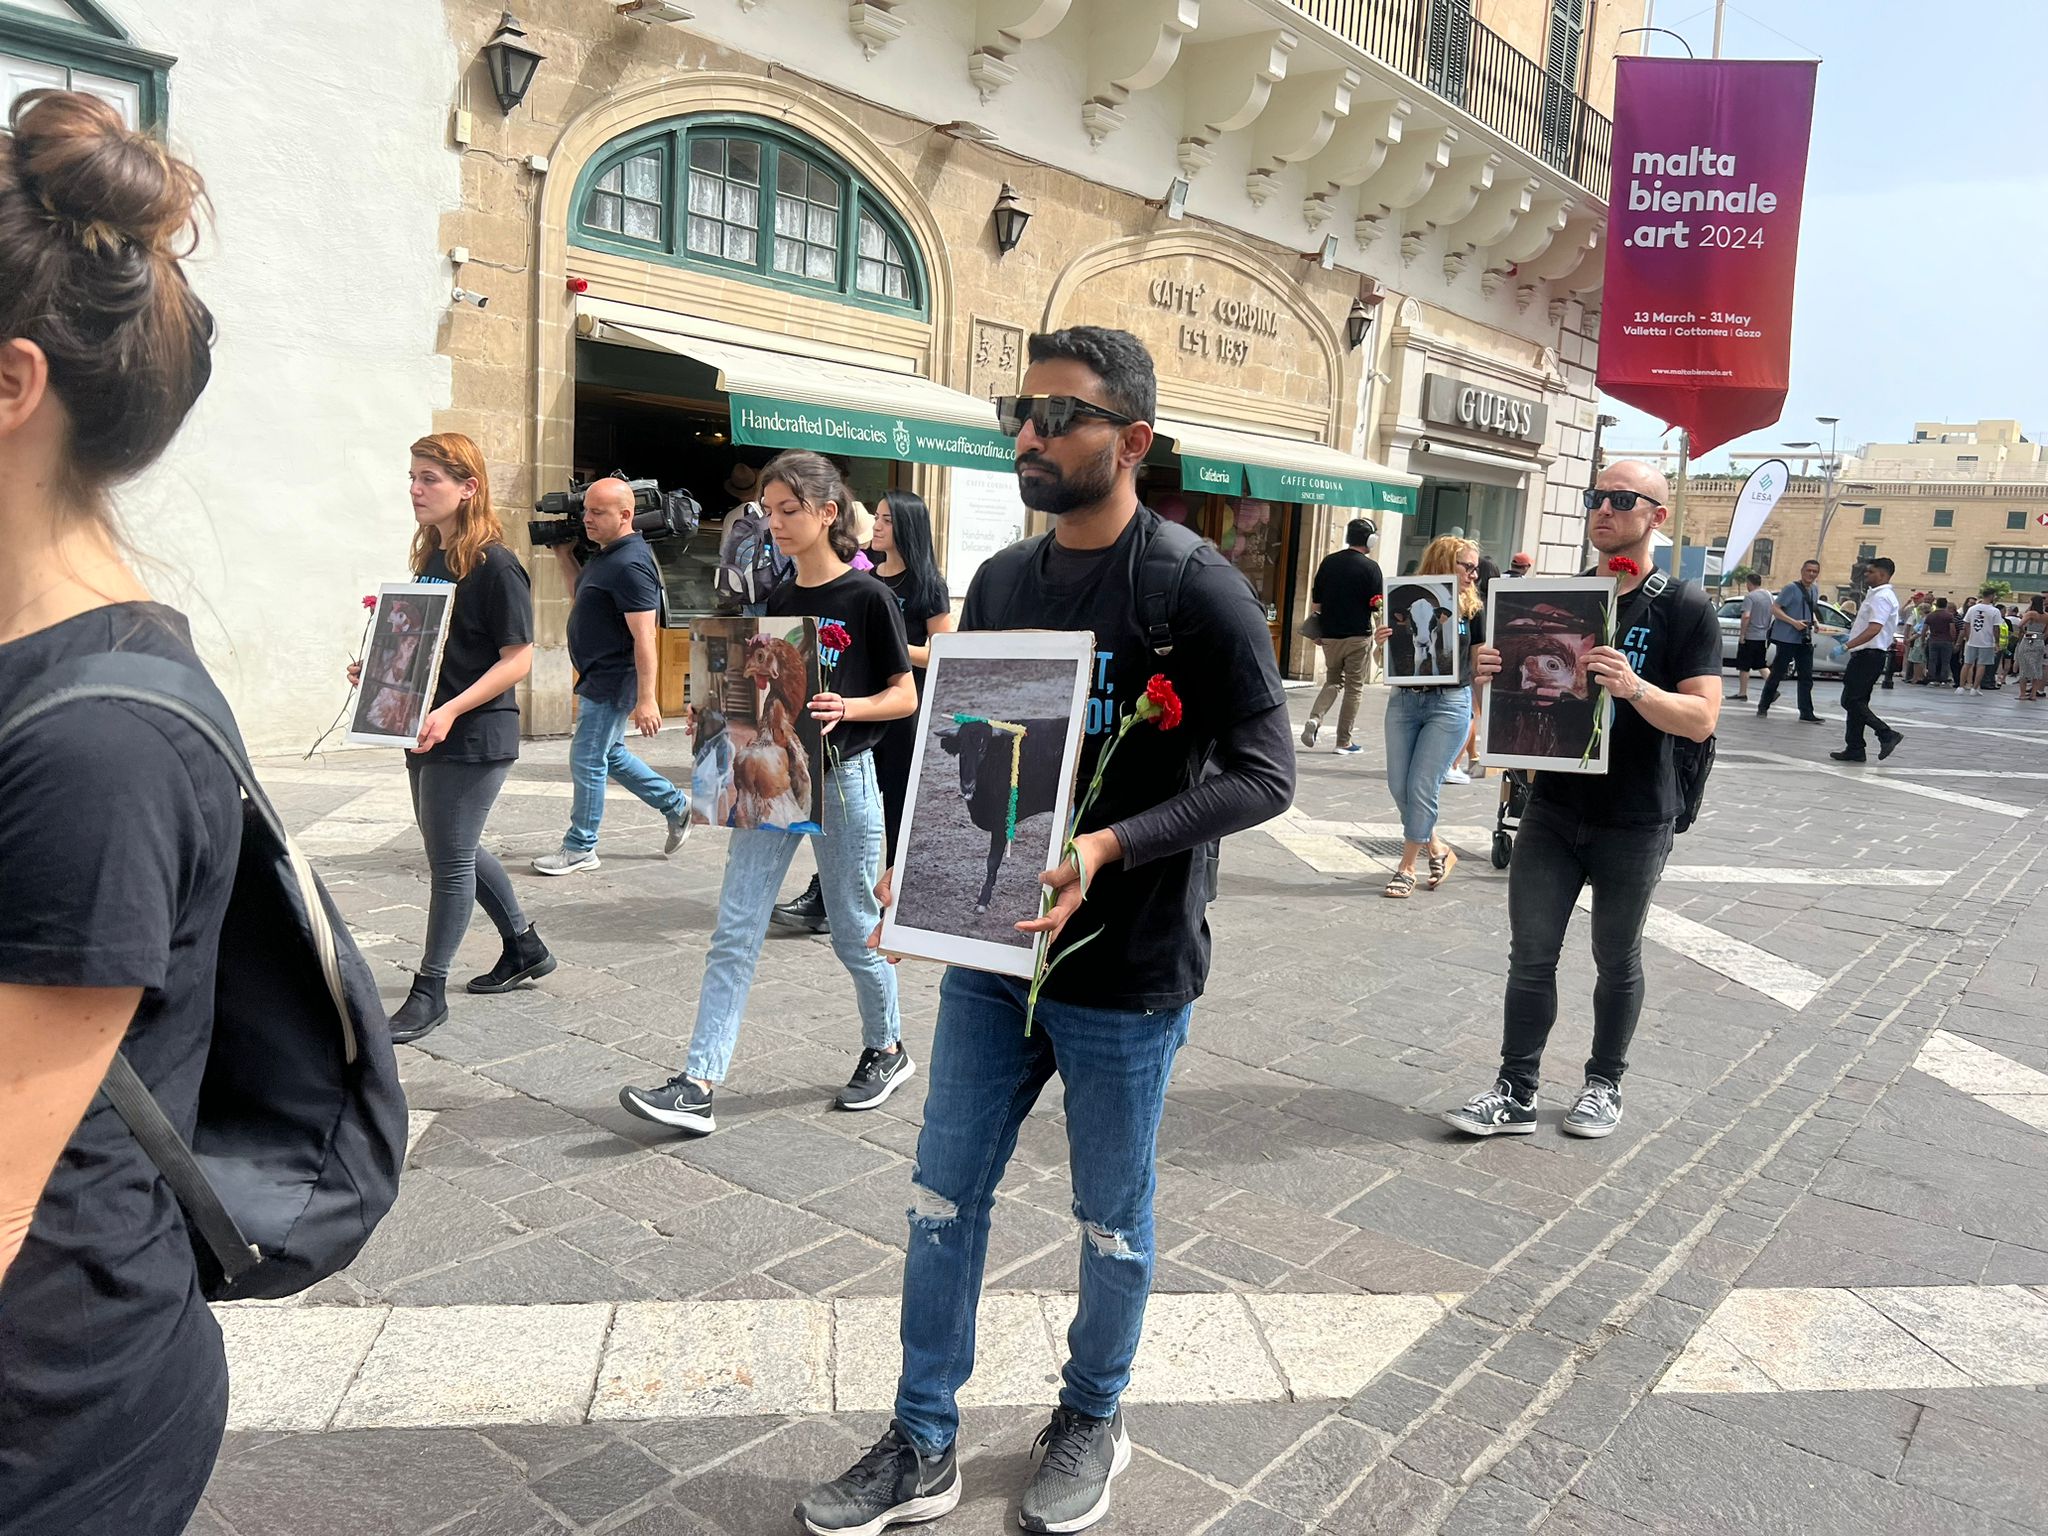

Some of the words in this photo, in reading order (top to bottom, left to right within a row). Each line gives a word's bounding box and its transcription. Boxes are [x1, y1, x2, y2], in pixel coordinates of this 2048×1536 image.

[1632, 146, 1736, 177] malta
[1628, 180, 1777, 213] biennale
[1624, 221, 1689, 249] .art
[1699, 225, 1764, 249] 2024
[1215, 298, 1278, 338] CORDINA
[1623, 326, 1666, 336] Valletta
[1674, 327, 1728, 337] Cottonera
[1735, 328, 1762, 338] Gozo
[1634, 312, 1649, 323] 13
[1652, 312, 1695, 323] March
[1710, 312, 1723, 323] 31
[1725, 313, 1751, 327] May
[1216, 334, 1248, 367] 1837
[1651, 368, 1733, 377] www.maltabiennale.art
[1459, 387, 1532, 435] GUESS
[741, 409, 822, 435] Handcrafted
[826, 420, 887, 443] Delicacies
[1199, 466, 1230, 483] Cafeteria
[1280, 474, 1306, 488] CAFFE
[1309, 477, 1343, 492] CORDINA
[1751, 491, 1772, 501] LESA
